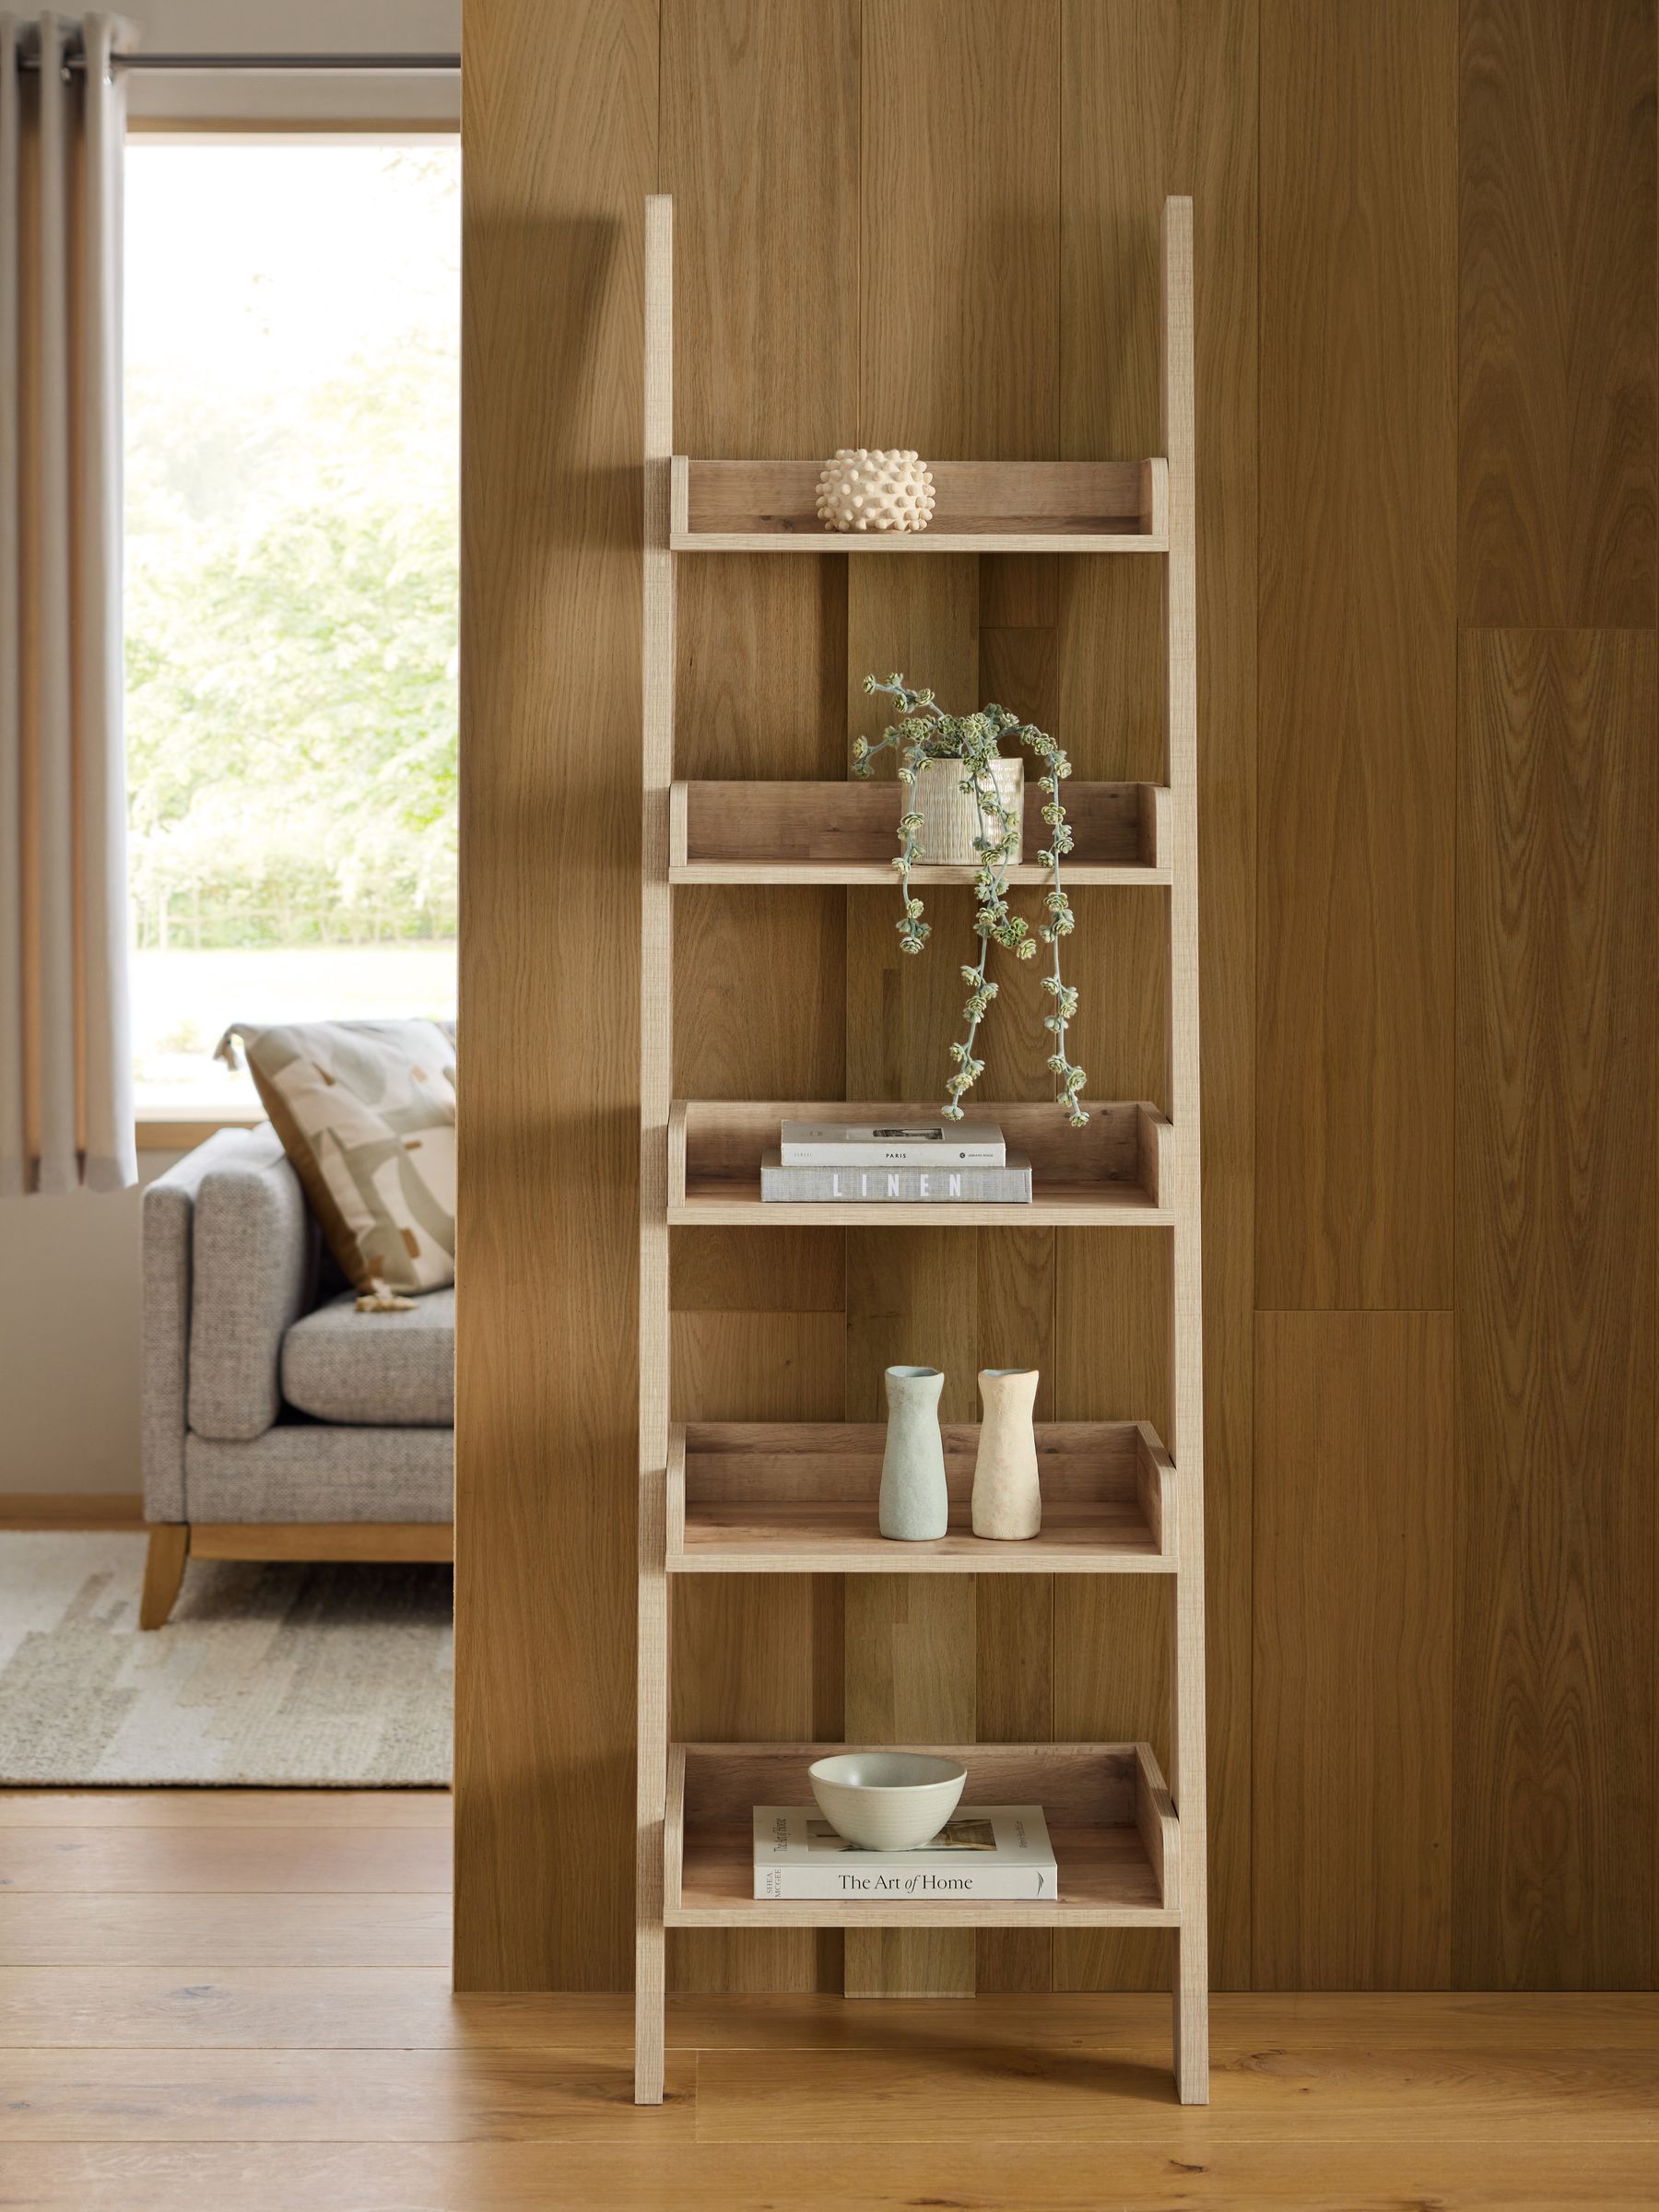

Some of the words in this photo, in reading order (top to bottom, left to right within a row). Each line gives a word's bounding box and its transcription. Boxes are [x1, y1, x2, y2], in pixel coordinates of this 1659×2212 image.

[833, 1173, 961, 1197] LINEN
[838, 1875, 871, 1889] The
[875, 1875, 900, 1889] Art
[904, 1875, 921, 1894] of
[923, 1875, 973, 1889] Home
